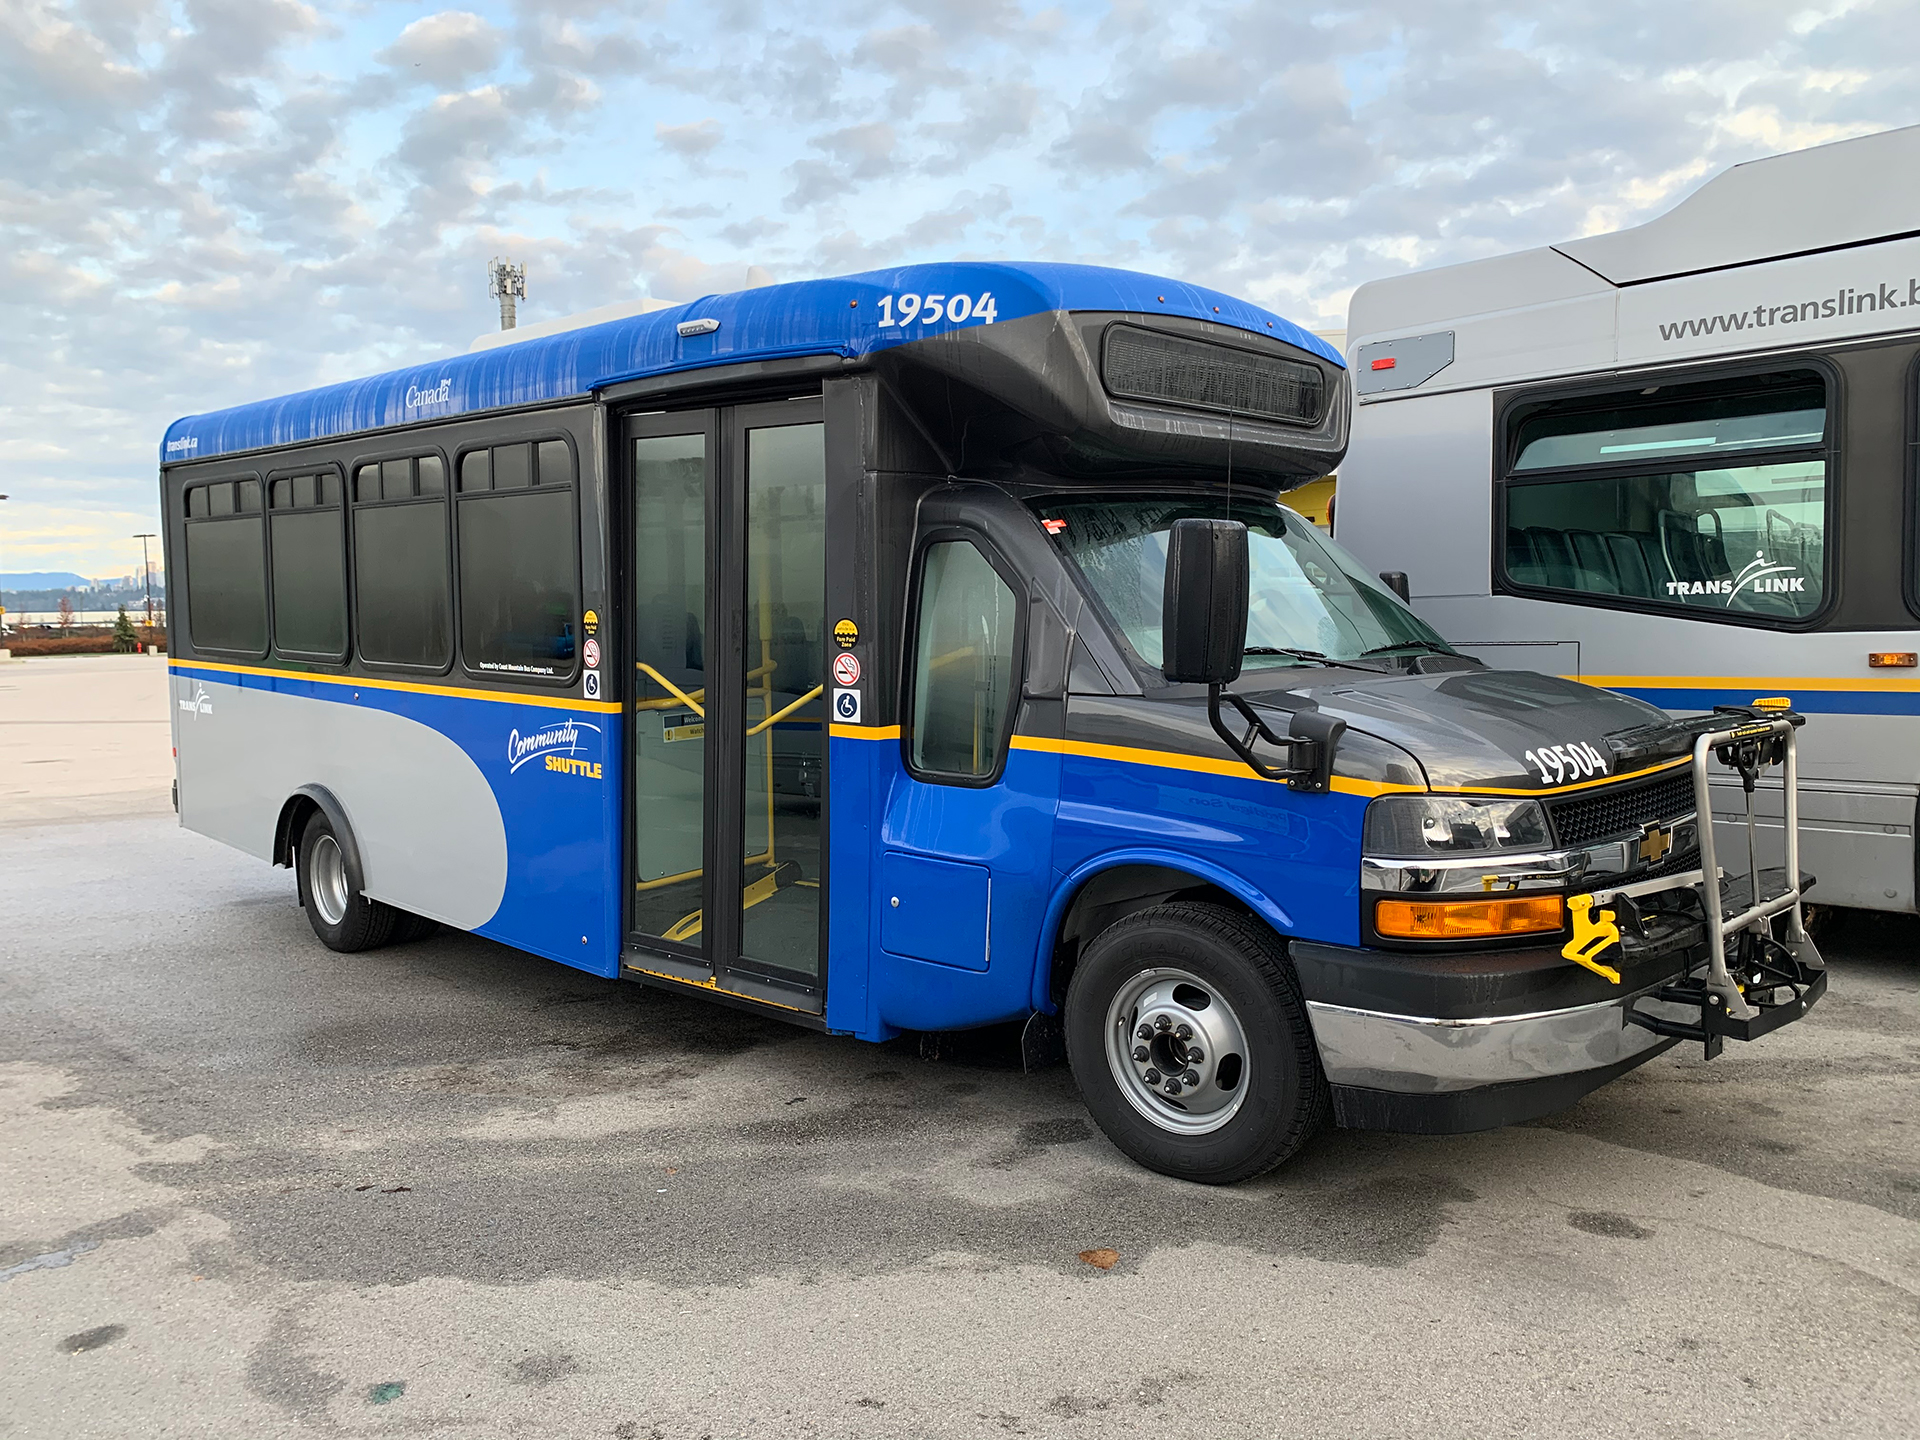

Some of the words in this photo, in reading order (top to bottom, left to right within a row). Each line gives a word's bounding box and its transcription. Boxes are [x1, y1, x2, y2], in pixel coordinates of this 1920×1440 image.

[877, 292, 998, 328] 19504
[405, 378, 450, 409] Canada
[1666, 580, 1733, 595] TRANS
[1753, 577, 1805, 593] LINK
[179, 699, 196, 712] TRANS
[200, 702, 213, 715] LINK
[508, 718, 579, 764] Community
[545, 755, 602, 779] SHUTTLE
[1525, 741, 1609, 785] 19504
